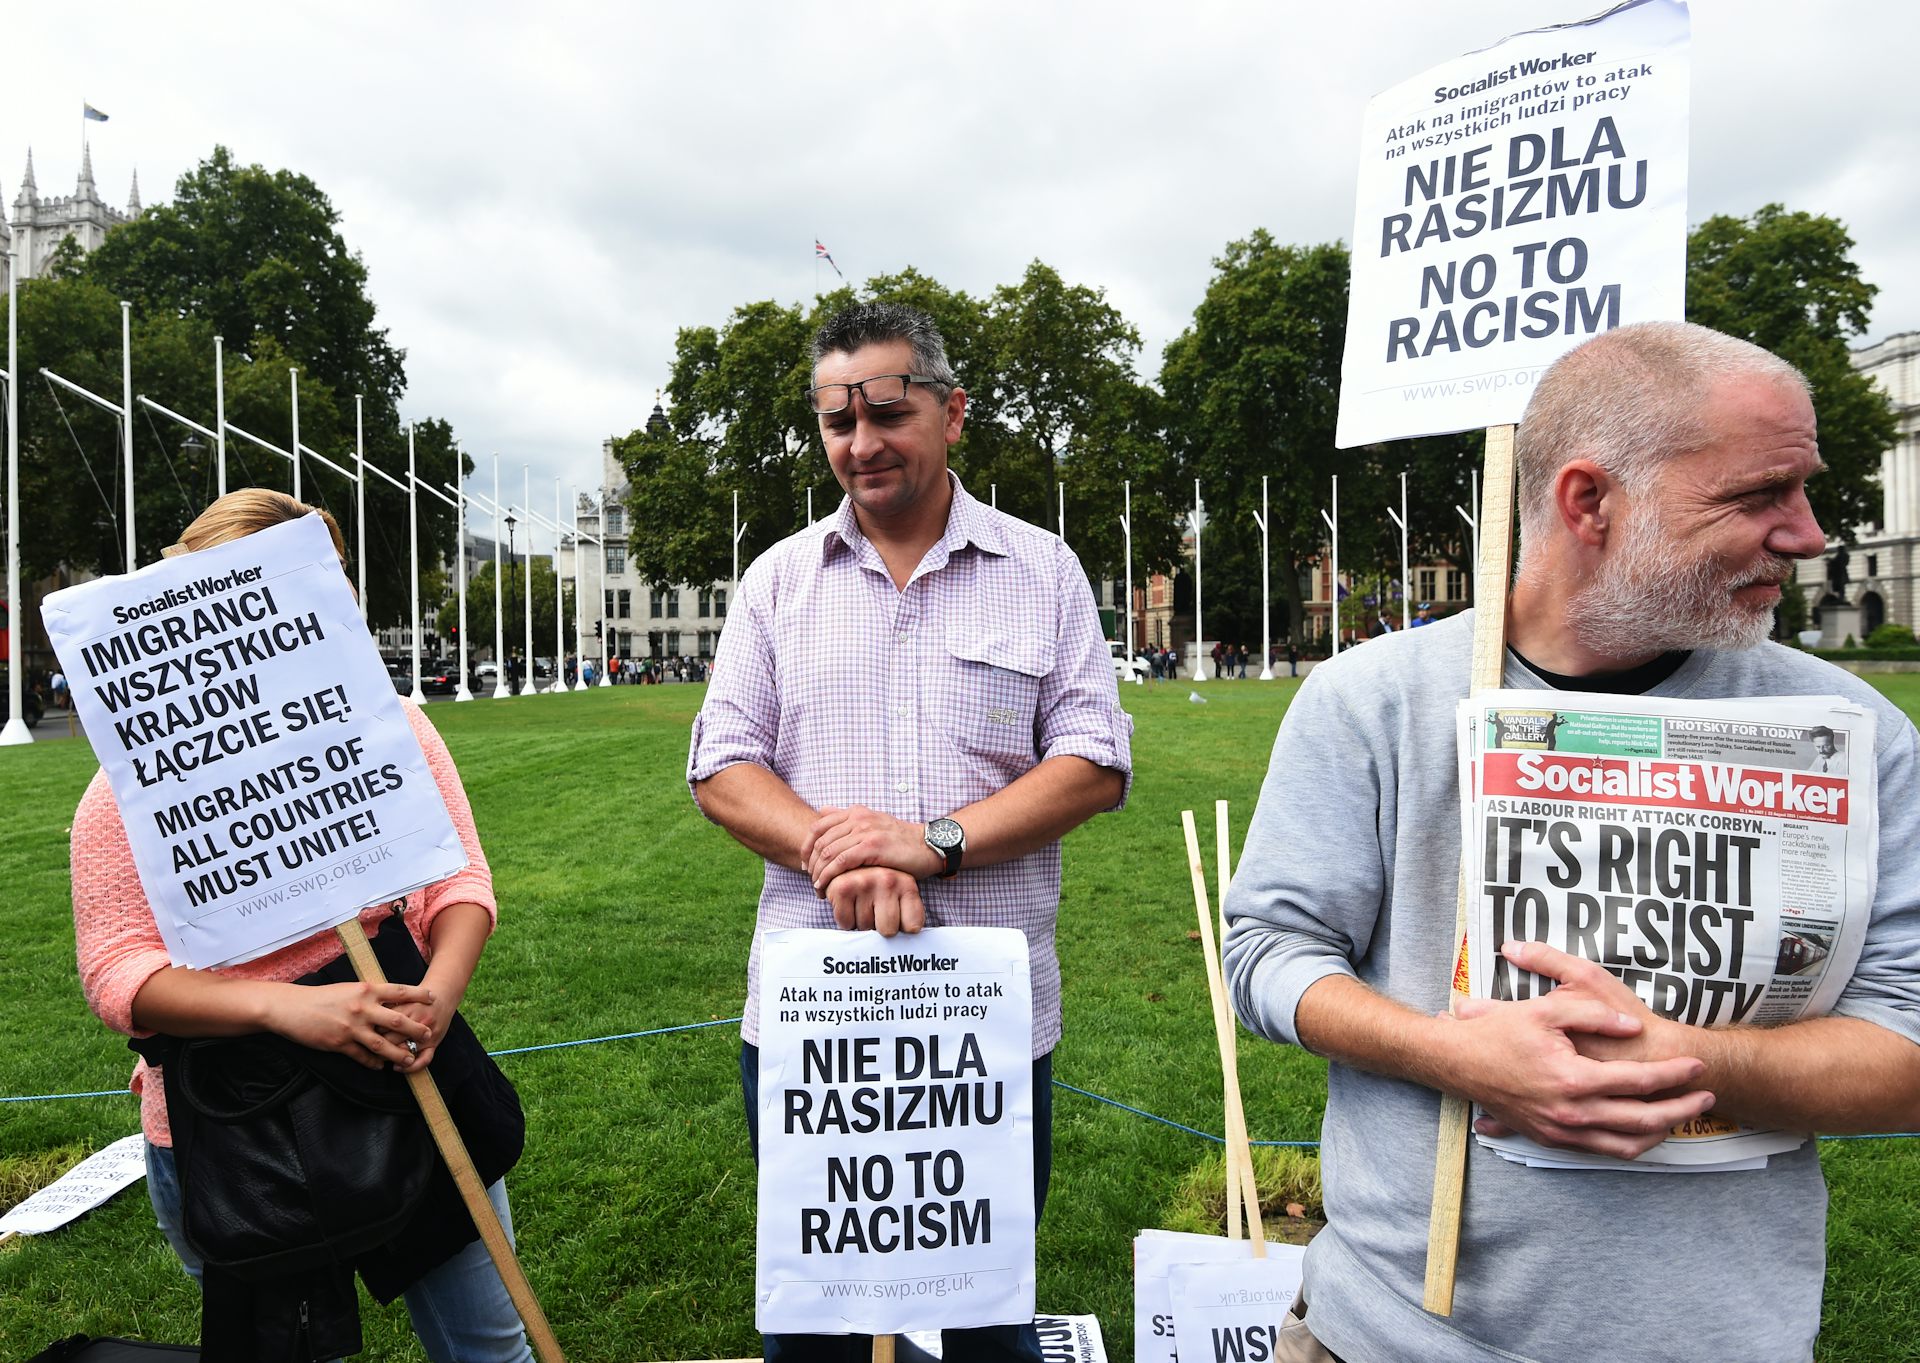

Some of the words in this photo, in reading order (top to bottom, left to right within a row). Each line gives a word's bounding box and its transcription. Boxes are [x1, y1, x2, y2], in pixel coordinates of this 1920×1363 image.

[1386, 119, 1426, 143] Atak
[1432, 112, 1453, 129] na
[1460, 81, 1569, 122] imigrantów
[1576, 73, 1596, 88] to
[1605, 64, 1652, 83] atak
[1386, 145, 1406, 160] na
[1412, 111, 1511, 152] wszystkich
[1518, 99, 1565, 120] ludzi
[1573, 84, 1631, 111] pracy
[1404, 144, 1492, 207] NIE
[1508, 116, 1625, 179] DLA
[1380, 160, 1647, 258] RASIZMU
[1420, 253, 1496, 309] NO
[1513, 237, 1588, 289] TO
[1386, 284, 1621, 362] RACISM
[1403, 370, 1540, 401] www.swp.or
[81, 587, 279, 676] IMIGRANCI
[95, 612, 324, 713] WSZYSTKICH
[114, 674, 259, 750] KRAJÓW
[132, 711, 279, 788] ŁĄCZCIE
[286, 684, 352, 732] SIĘ!
[1504, 717, 1546, 725] VANDALS
[1504, 733, 1545, 742] GALLERY
[1509, 725, 1521, 733] IN
[1522, 725, 1541, 733] THE
[1668, 720, 1728, 733] TROTSKY
[1732, 725, 1757, 735] FOR
[1760, 727, 1803, 739] TODAY
[154, 757, 320, 837] MIGRANTS
[326, 737, 364, 772] OF
[1516, 754, 1695, 803] Socialist
[1699, 764, 1845, 815] Worker
[172, 835, 227, 873] ALL
[229, 764, 402, 848] COUNTRIES
[1487, 800, 1507, 814] AS
[1511, 801, 1574, 819] LABOUR
[1578, 806, 1626, 822] RIGHT
[1632, 810, 1696, 827] ATTACK
[1700, 815, 1777, 836] CORBYN...
[1782, 840, 1816, 849] crackdown
[1818, 842, 1830, 851] kills
[1783, 831, 1809, 840] Europe's
[184, 854, 274, 907] MUST
[282, 810, 380, 869] UNITE!
[236, 844, 392, 918] www.swp.org.uk
[1484, 816, 1582, 889] IT'S
[1599, 824, 1760, 907] RIGHT
[1800, 850, 1826, 859] refugees
[1484, 885, 1549, 953] TO
[1566, 892, 1754, 979] RESIST
[780, 986, 817, 1003] Atak
[823, 988, 843, 1002] na
[849, 982, 939, 1005] imigrantów
[945, 983, 961, 998] to
[967, 982, 1003, 997] atak
[780, 1009, 800, 1022] na
[805, 1005, 894, 1026] wszystkich
[901, 1003, 937, 1020] ludzi
[944, 1005, 988, 1020] pracy
[803, 1037, 881, 1084] NIE
[895, 1032, 987, 1082] DLA
[784, 1081, 1004, 1135] RASIZMU
[1683, 1119, 1691, 1135] 4
[828, 1154, 893, 1202] NO
[905, 1149, 964, 1199] TO
[802, 1199, 991, 1254] RACISM
[822, 1277, 974, 1300] www.swp.org.uk
